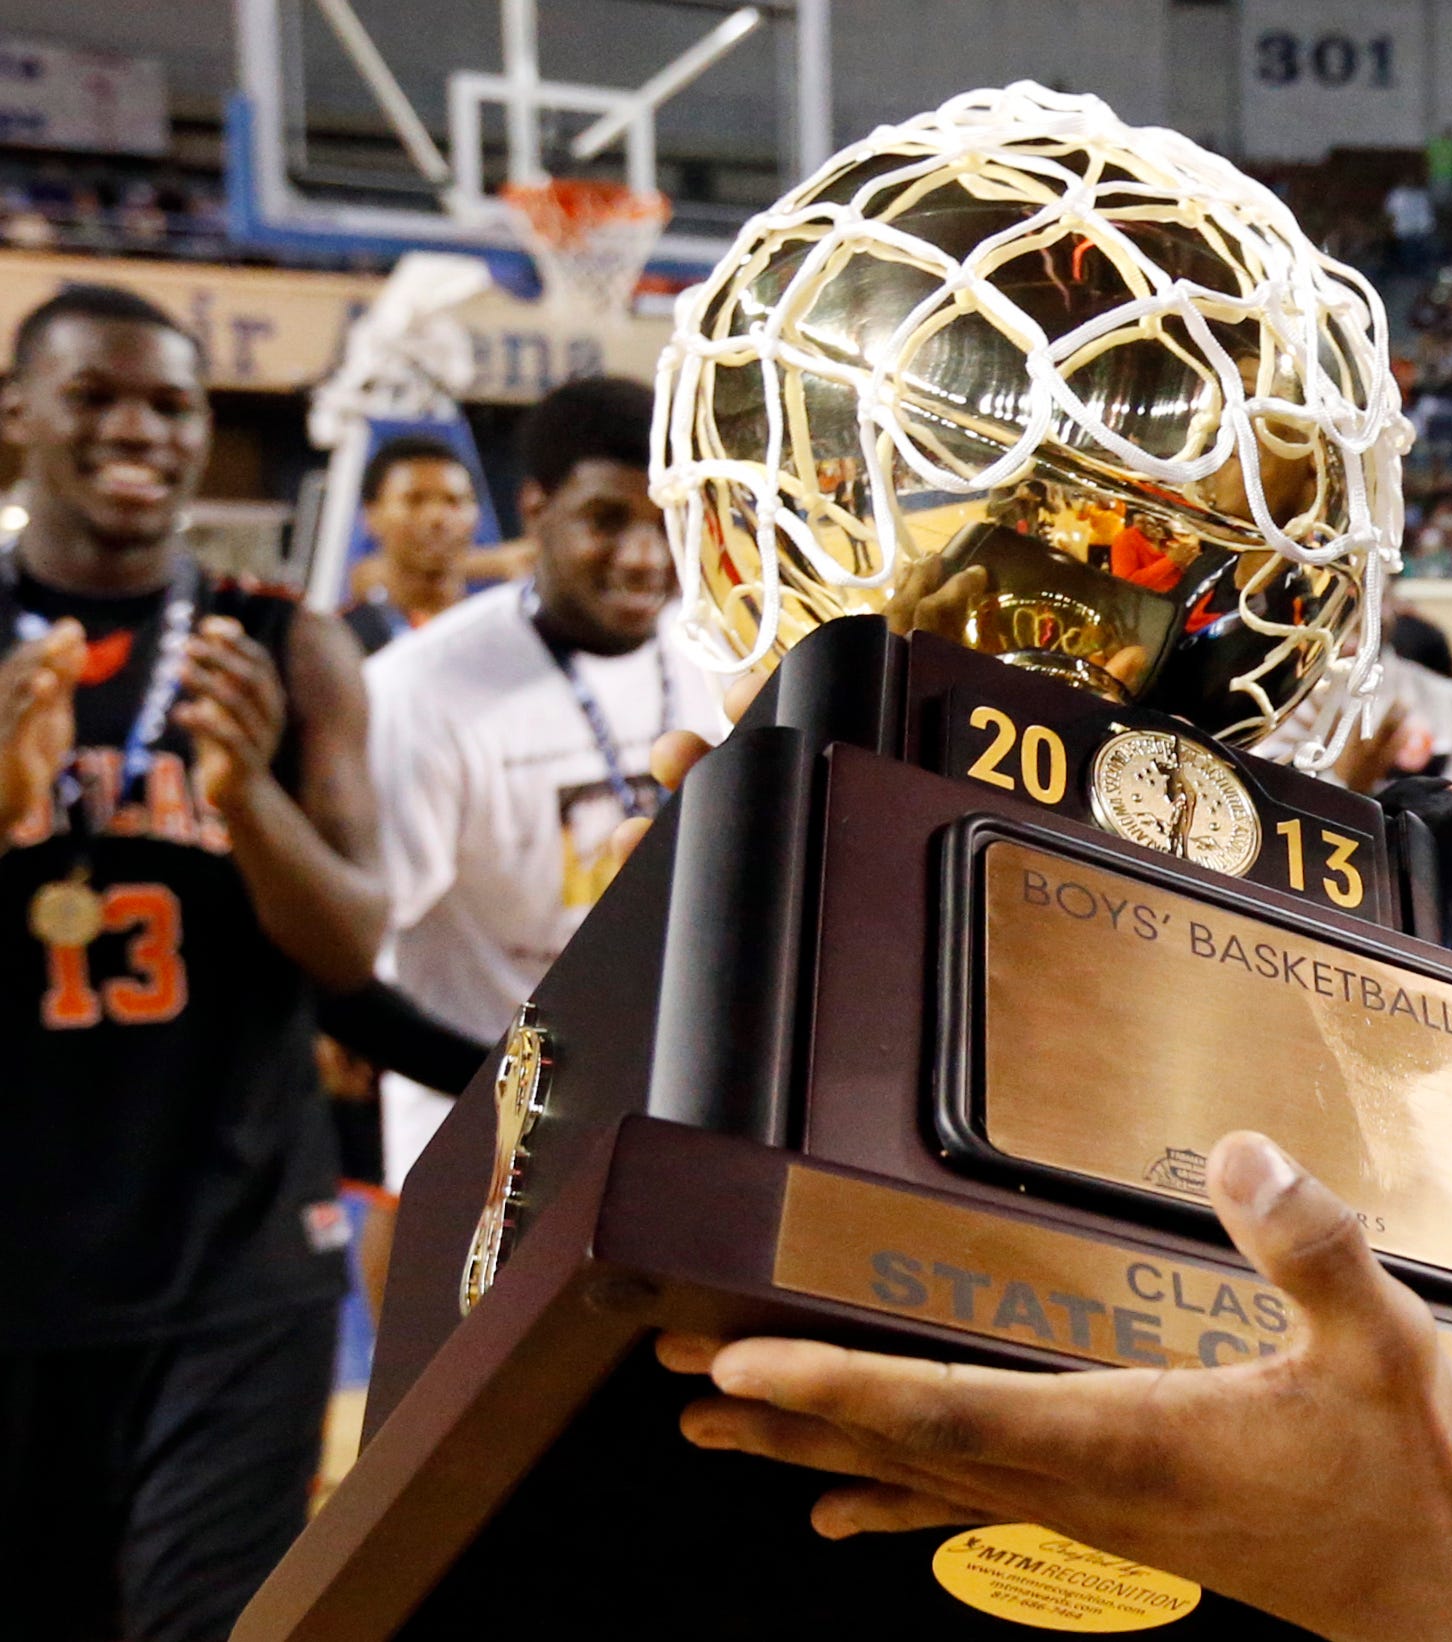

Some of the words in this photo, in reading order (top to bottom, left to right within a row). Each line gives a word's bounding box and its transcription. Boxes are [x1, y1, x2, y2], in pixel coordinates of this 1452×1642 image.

[1256, 32, 1396, 90] 301
[968, 706, 1067, 804] 20
[1276, 819, 1364, 909] 13
[1023, 869, 1171, 941] BOYS'
[41, 882, 189, 1030] 13
[869, 1249, 1169, 1368] STATE
[979, 1546, 1044, 1573] MTM
